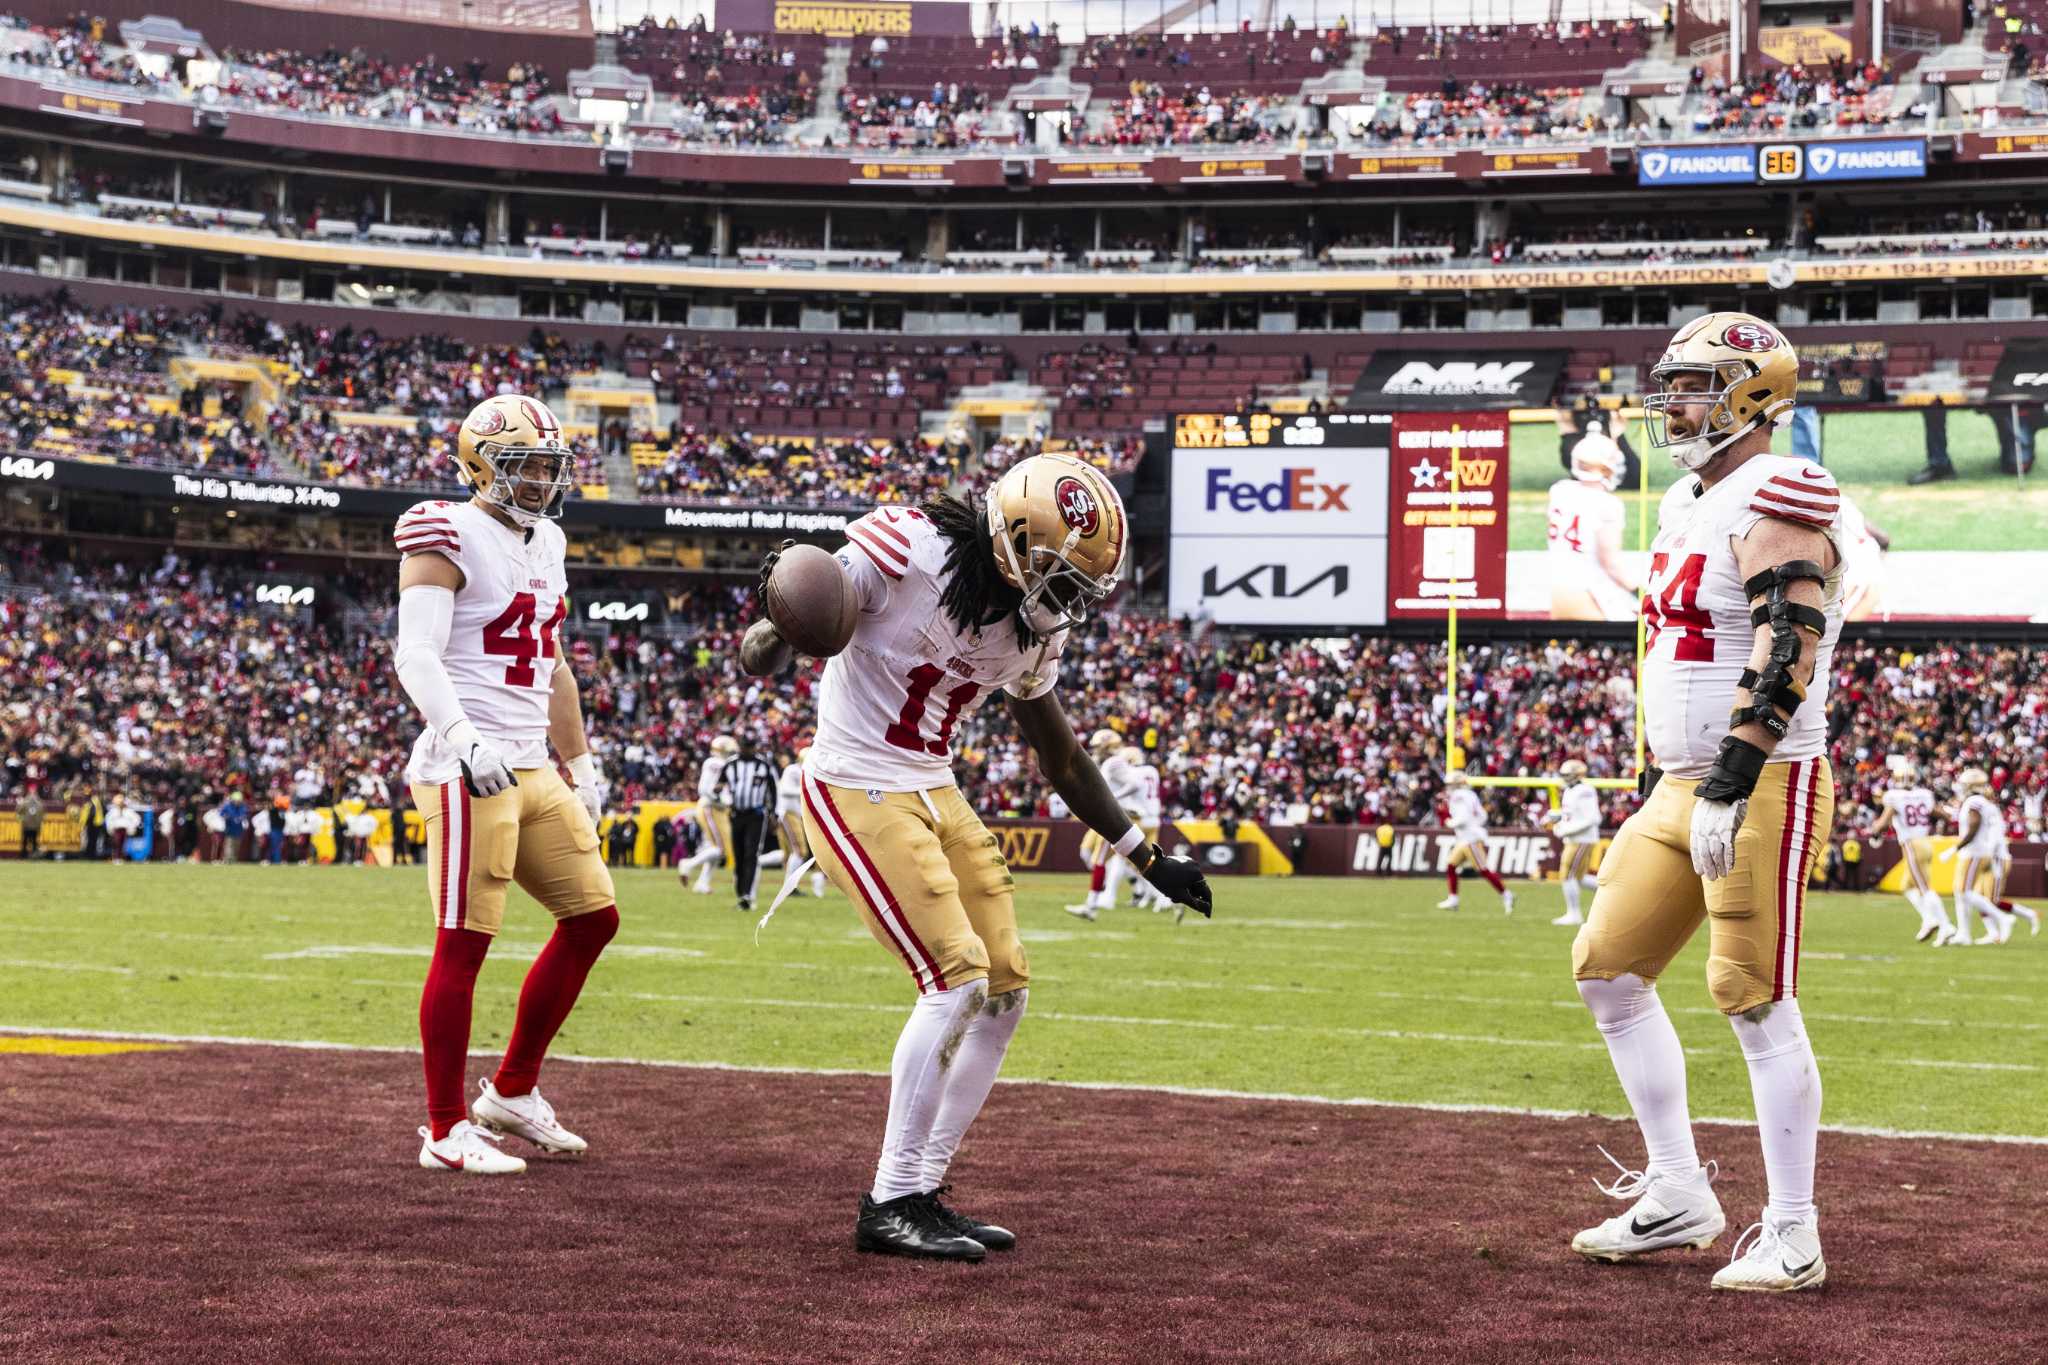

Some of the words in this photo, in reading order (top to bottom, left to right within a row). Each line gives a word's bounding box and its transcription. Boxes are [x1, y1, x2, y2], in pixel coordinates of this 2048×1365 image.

[774, 8, 912, 32] COMMANDERS
[1670, 156, 1755, 174] FANDUEL
[1766, 152, 1796, 174] 36
[1838, 150, 1923, 169] FANDUEL
[1397, 275, 1414, 288] 5
[1421, 274, 1482, 287] TIME
[1491, 271, 1585, 286] WORLD
[1592, 266, 1751, 285] CHAMPIONS
[1812, 265, 1867, 278] 1937
[1891, 263, 1950, 276] 1942
[1974, 260, 2034, 273] 1982
[172, 475, 202, 496] The
[203, 479, 227, 498] Kia
[228, 480, 294, 504] Telluride
[295, 486, 341, 508] X-Pro
[1206, 468, 1350, 513] FedEx
[665, 507, 749, 529] Movement
[751, 510, 784, 529] that
[785, 511, 847, 533] inspires
[1202, 565, 1349, 599] KIA
[884, 662, 983, 757] 11
